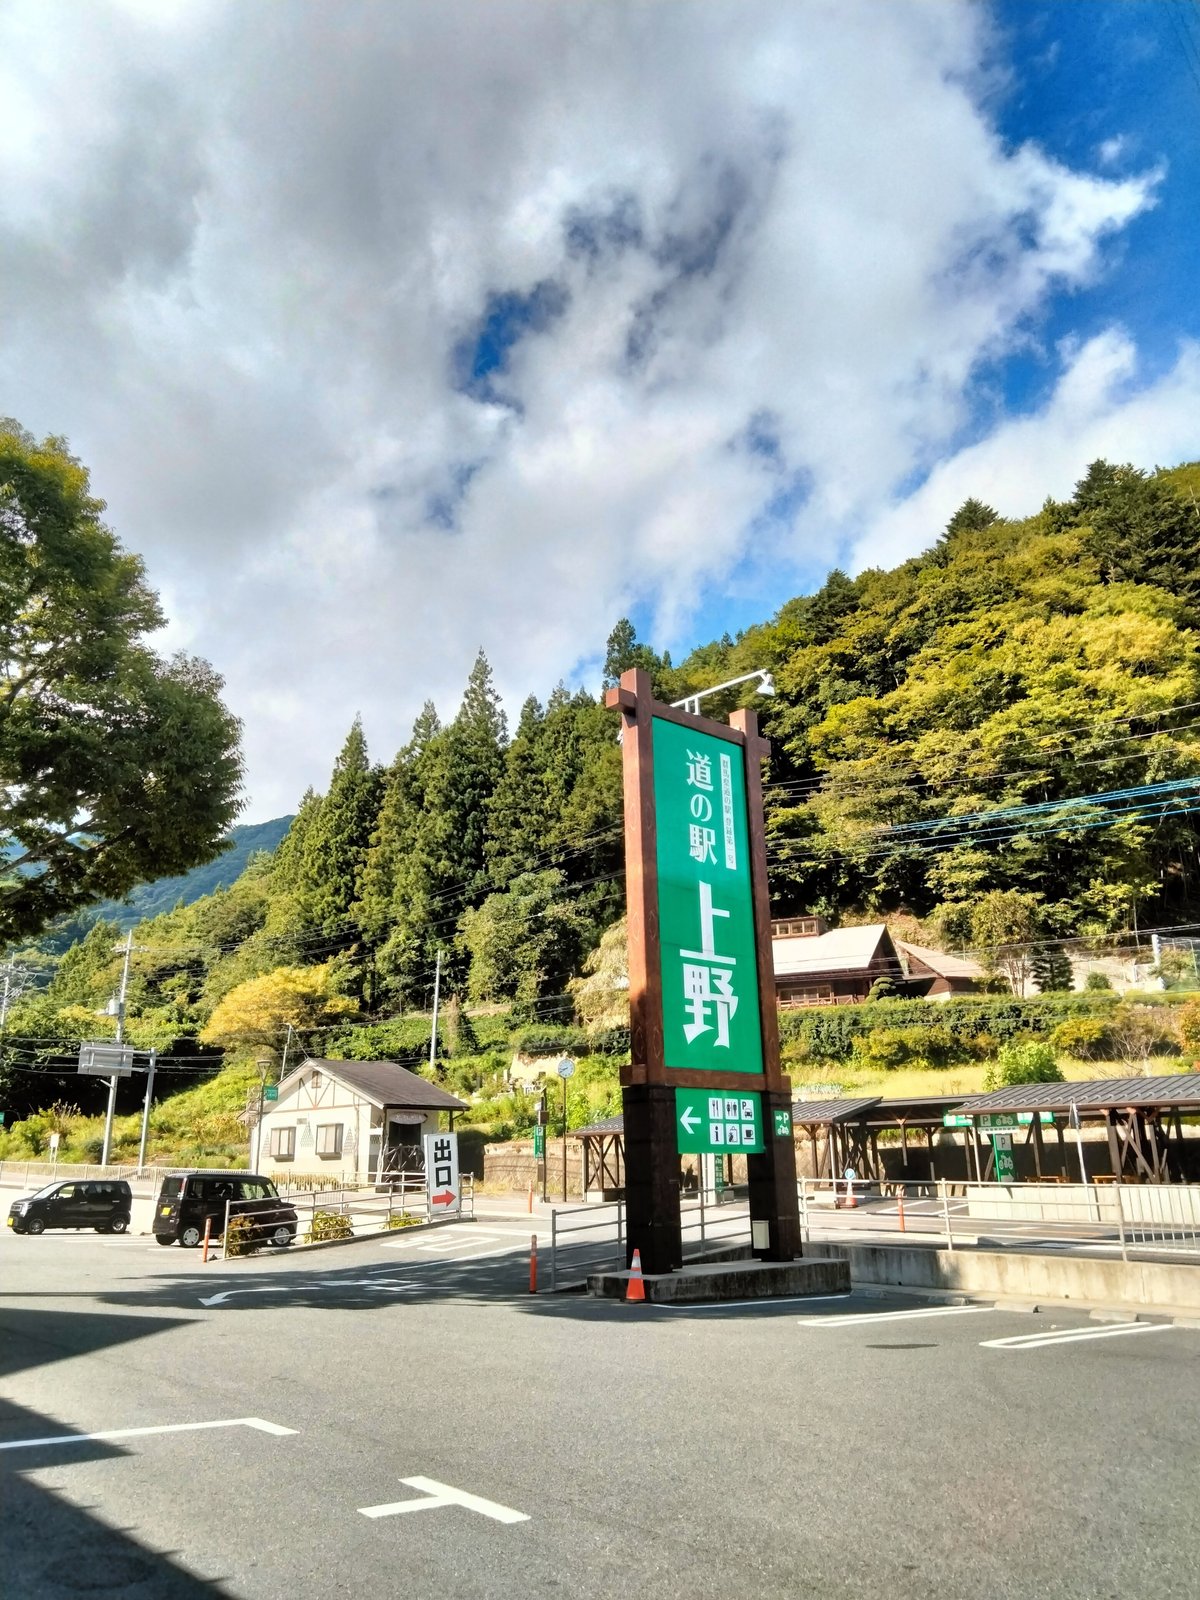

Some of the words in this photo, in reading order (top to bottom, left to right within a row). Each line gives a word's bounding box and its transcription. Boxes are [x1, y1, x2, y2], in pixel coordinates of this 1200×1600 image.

[686, 748, 717, 866] 道の駅
[679, 880, 739, 1049] 上野
[742, 1101, 747, 1110] P
[783, 1112, 790, 1124] P
[983, 1115, 989, 1125] P
[1001, 1137, 1006, 1147] P
[434, 1138, 452, 1188] 出口
